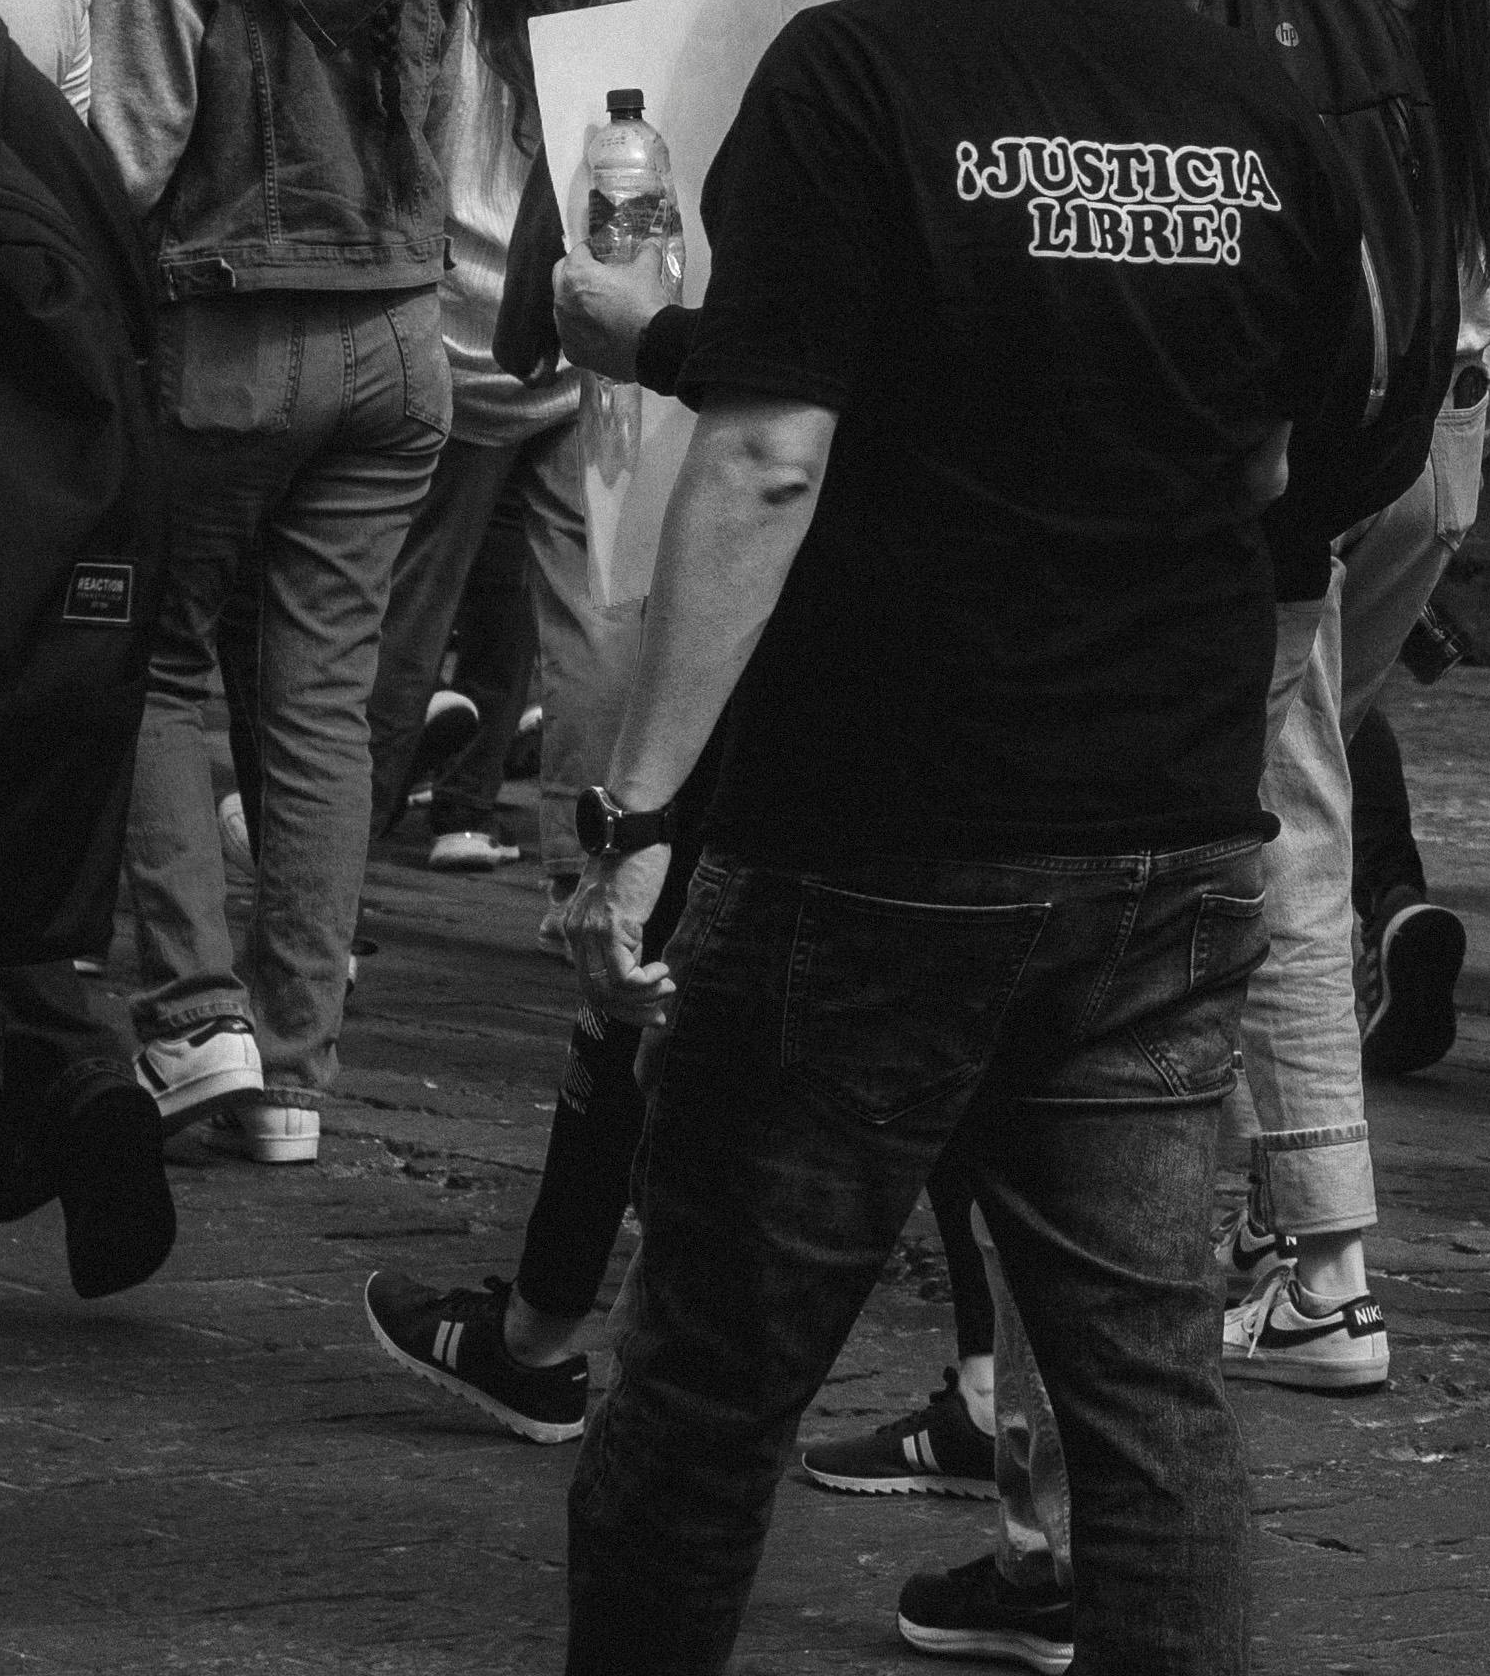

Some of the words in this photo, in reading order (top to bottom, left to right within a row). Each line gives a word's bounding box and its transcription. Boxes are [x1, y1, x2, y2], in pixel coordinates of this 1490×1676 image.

[1279, 23, 1298, 47] hp
[956, 136, 1282, 212] ¡JUSTICIA
[1027, 196, 1243, 266] LIBRE!
